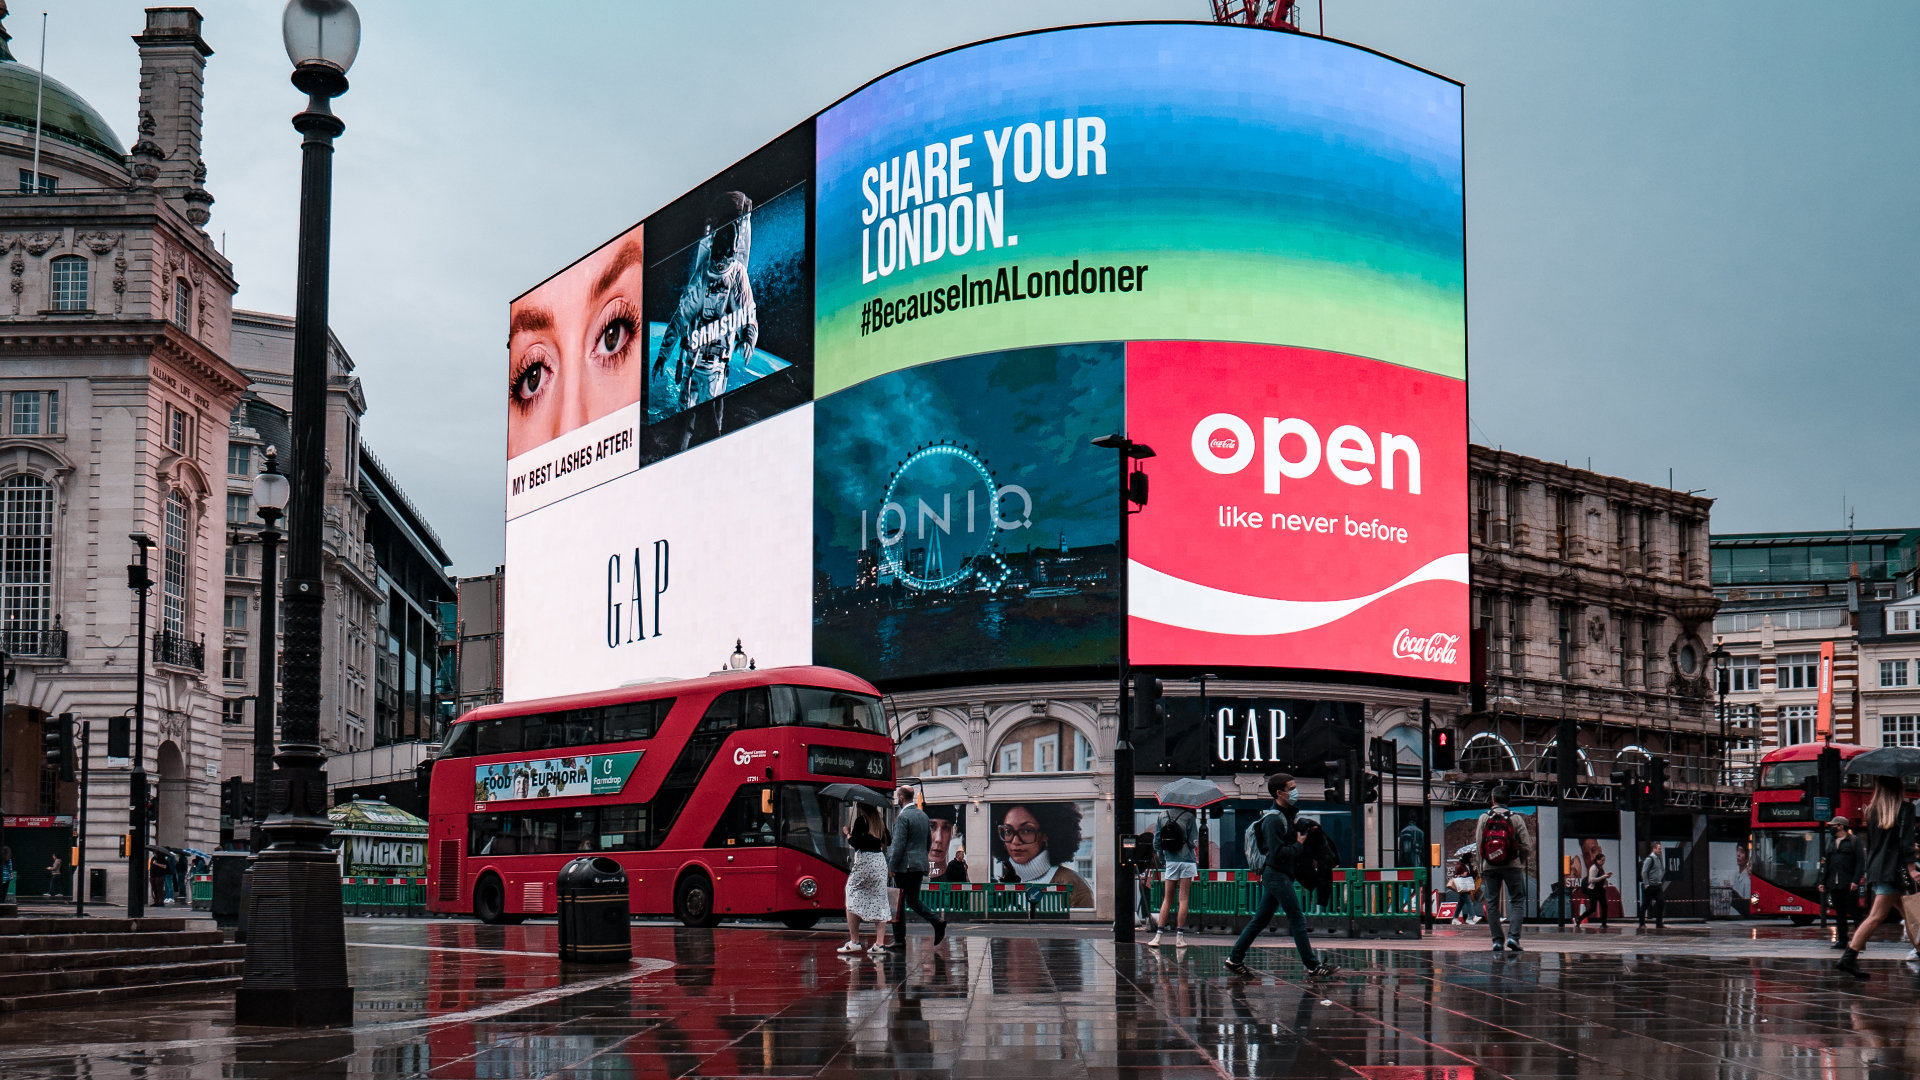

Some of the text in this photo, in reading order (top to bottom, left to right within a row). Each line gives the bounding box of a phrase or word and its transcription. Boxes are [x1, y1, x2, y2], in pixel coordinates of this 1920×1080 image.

[862, 116, 1107, 225] SHARE YOUR
[862, 189, 1018, 285] LONDON.
[861, 259, 1149, 337] #BecauseImALondoner
[691, 302, 757, 350] SAMSUNG
[152, 366, 210, 410] ALLIANCE LIFE OFFICE
[512, 428, 633, 496] MY BEST LASHES AFTER!
[1191, 412, 1421, 495] open
[861, 484, 1033, 551] IONIQ
[1218, 505, 1408, 544] like never before
[607, 538, 669, 649] GAP
[1392, 628, 1460, 664] Coca-Cola
[1217, 707, 1287, 761] GAP
[484, 767, 588, 791] FOOD EUPHORIA
[593, 776, 622, 785] Farmdrop
[814, 754, 883, 775] Deptford Bridge 453
[1772, 808, 1800, 816] Victoria
[352, 837, 423, 866] WICKED
[1669, 857, 1681, 871] GAP
